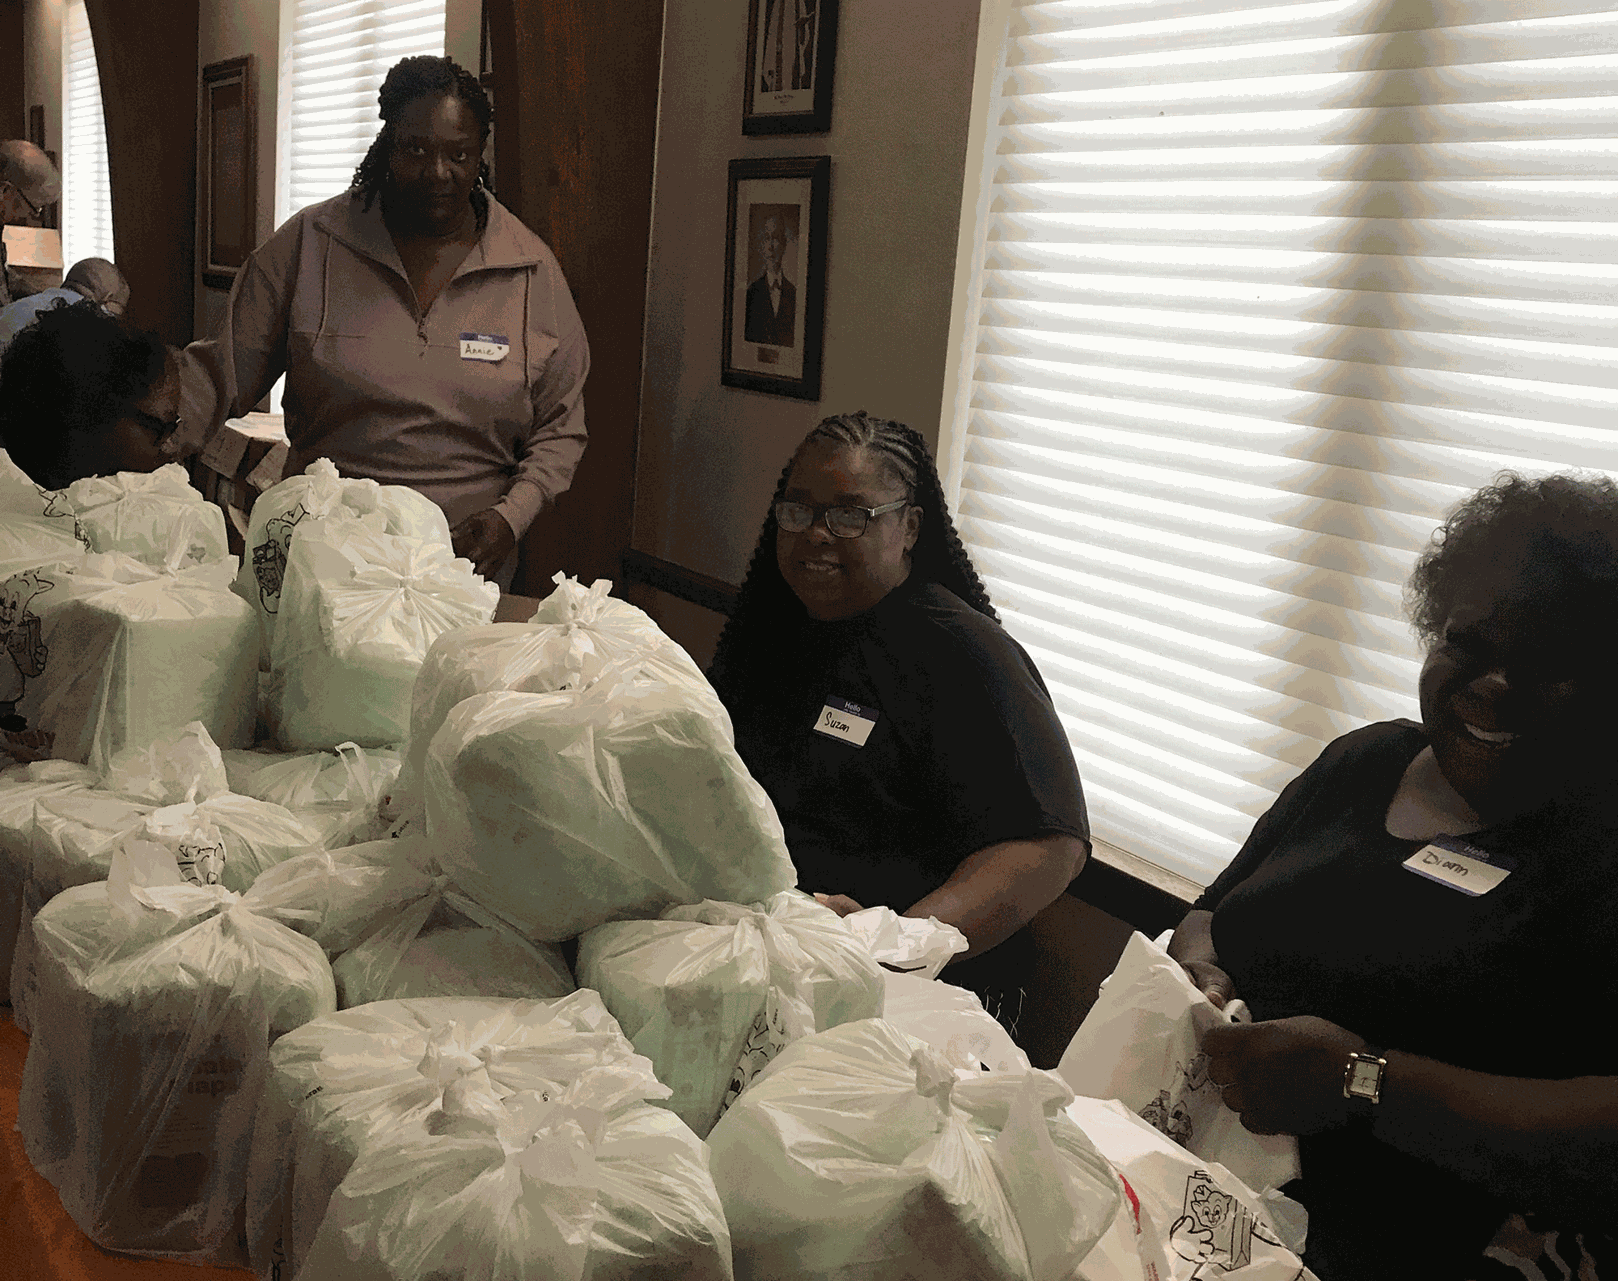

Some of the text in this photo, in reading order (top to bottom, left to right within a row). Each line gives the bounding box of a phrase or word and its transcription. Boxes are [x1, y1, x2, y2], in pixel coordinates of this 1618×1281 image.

[465, 343, 495, 356] Annie
[844, 701, 861, 712] Hello
[824, 711, 850, 733] Suzan
[1463, 845, 1490, 859] Hello
